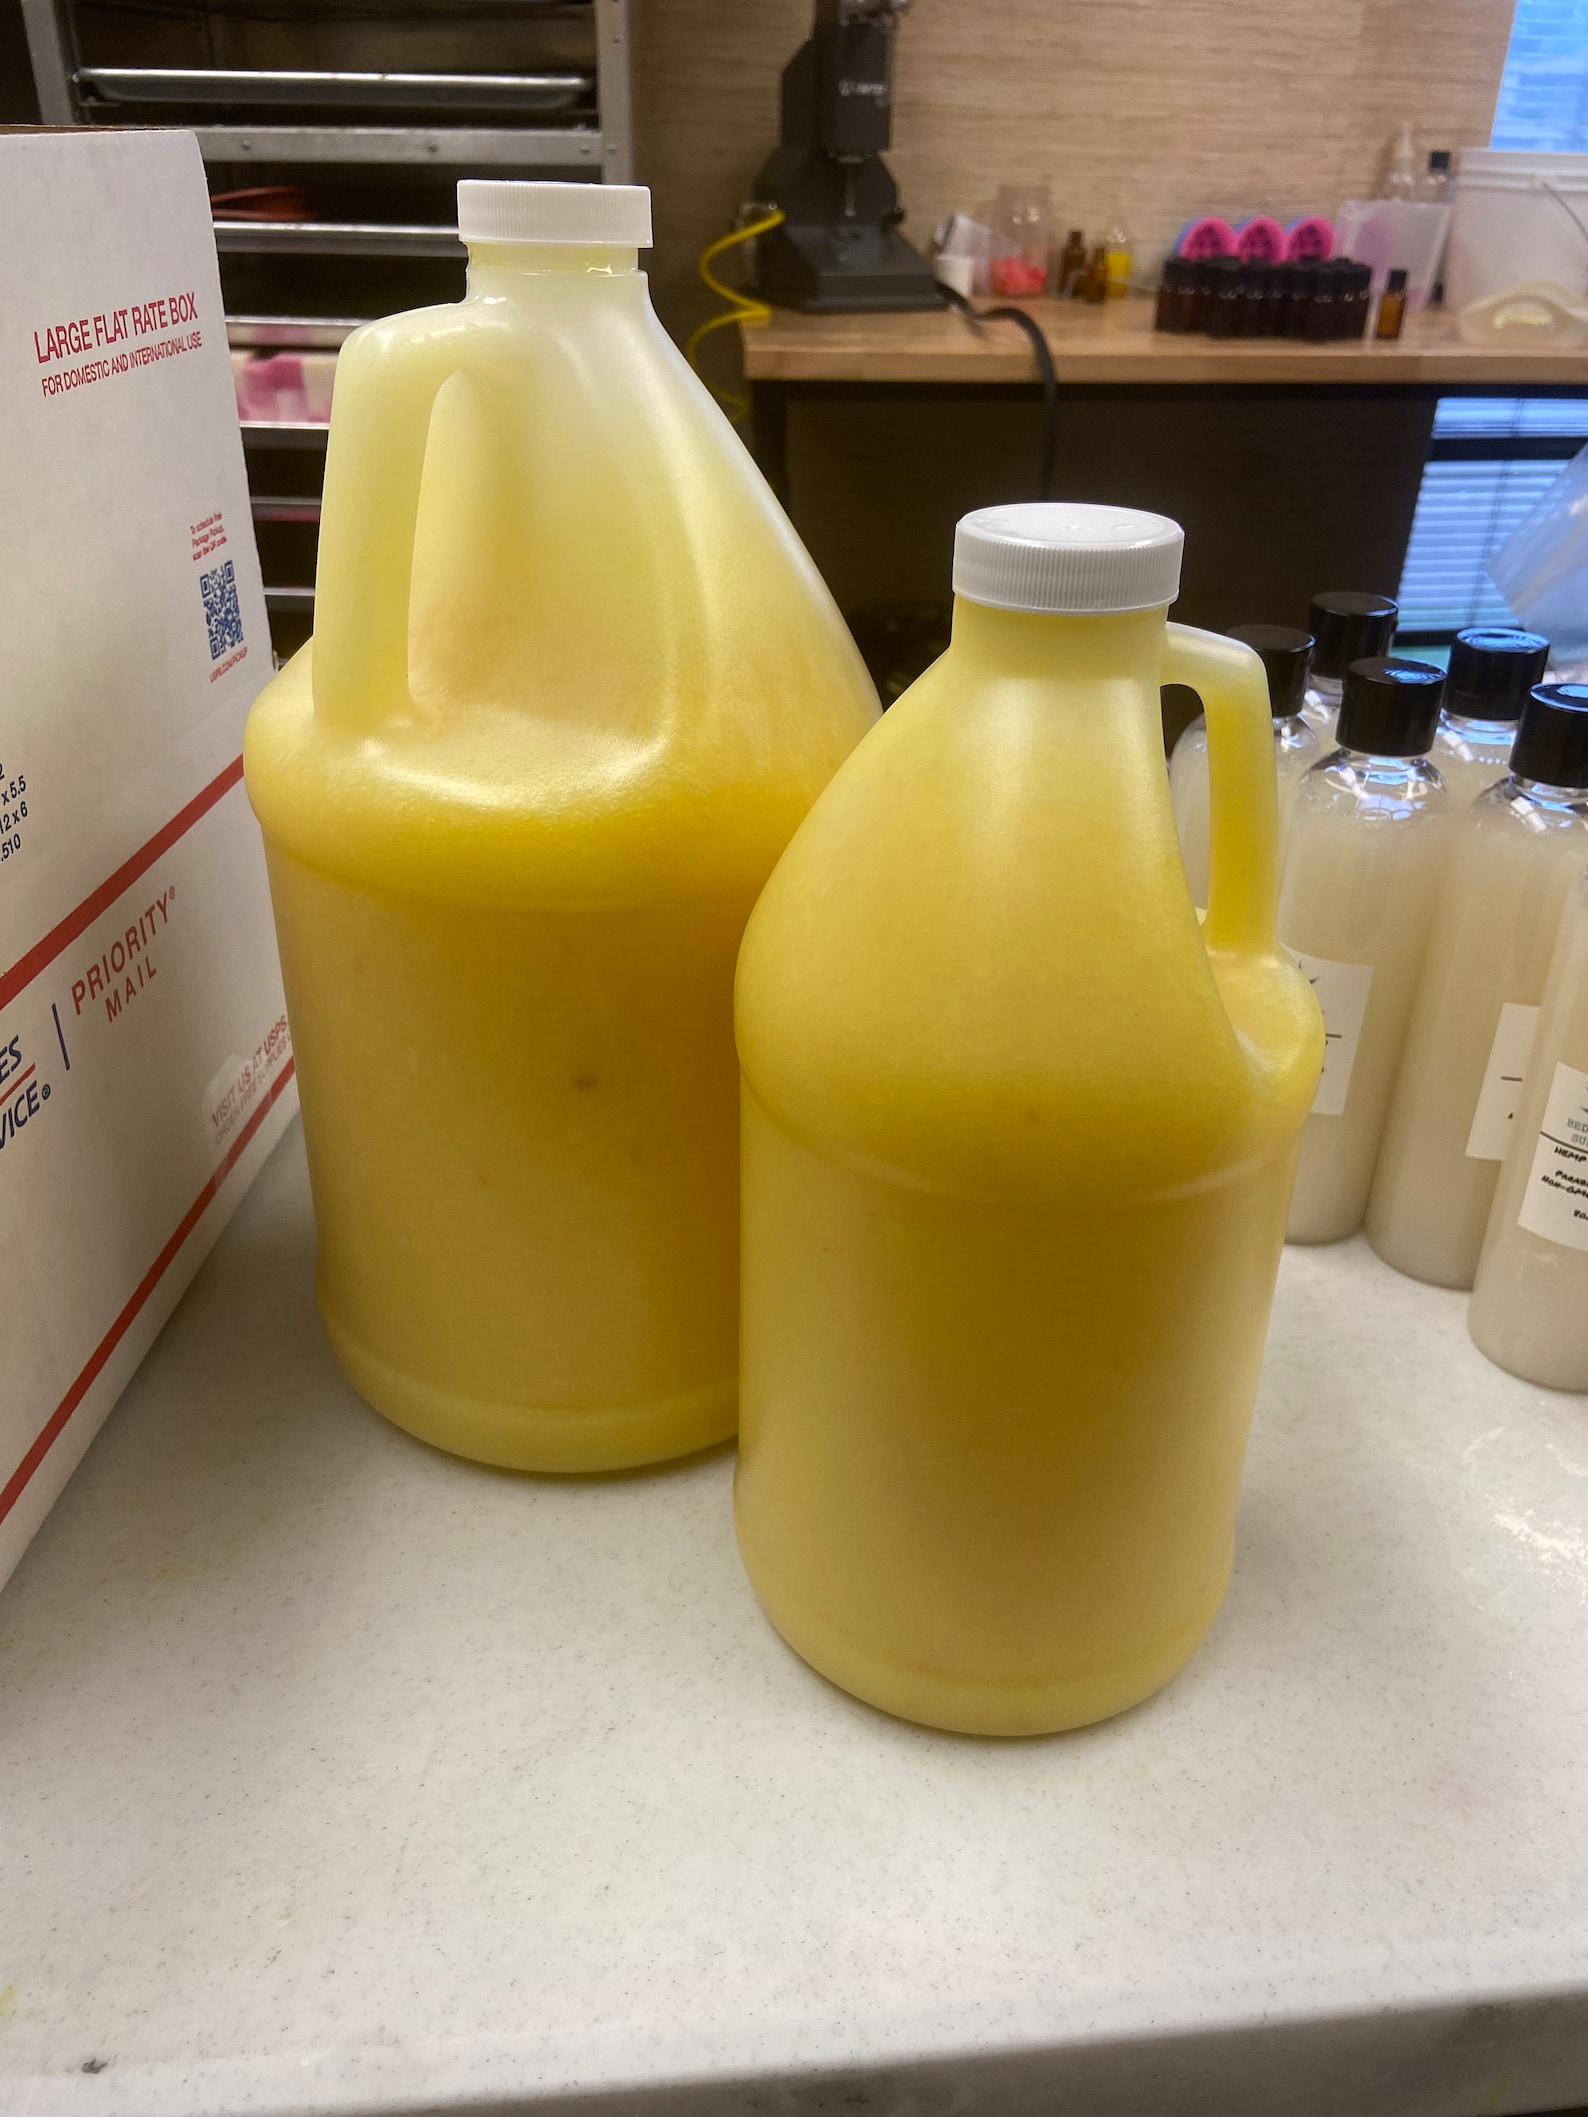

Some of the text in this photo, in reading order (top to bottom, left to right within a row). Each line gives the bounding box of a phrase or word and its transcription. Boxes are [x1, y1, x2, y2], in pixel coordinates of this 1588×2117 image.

[34, 291, 198, 364] LARGE FLAT RATE BOX
[41, 330, 202, 398] FOR DOMESTIC AND INTERNATIONAL USE
[9, 774, 27, 799] 5.5
[20, 800, 28, 818] 6
[104, 955, 157, 1025] MAIL
[211, 1085, 237, 1128] VISIT
[236, 1065, 253, 1094] US
[251, 1045, 264, 1076] AT
[1554, 1145, 1587, 1163] HEMP
